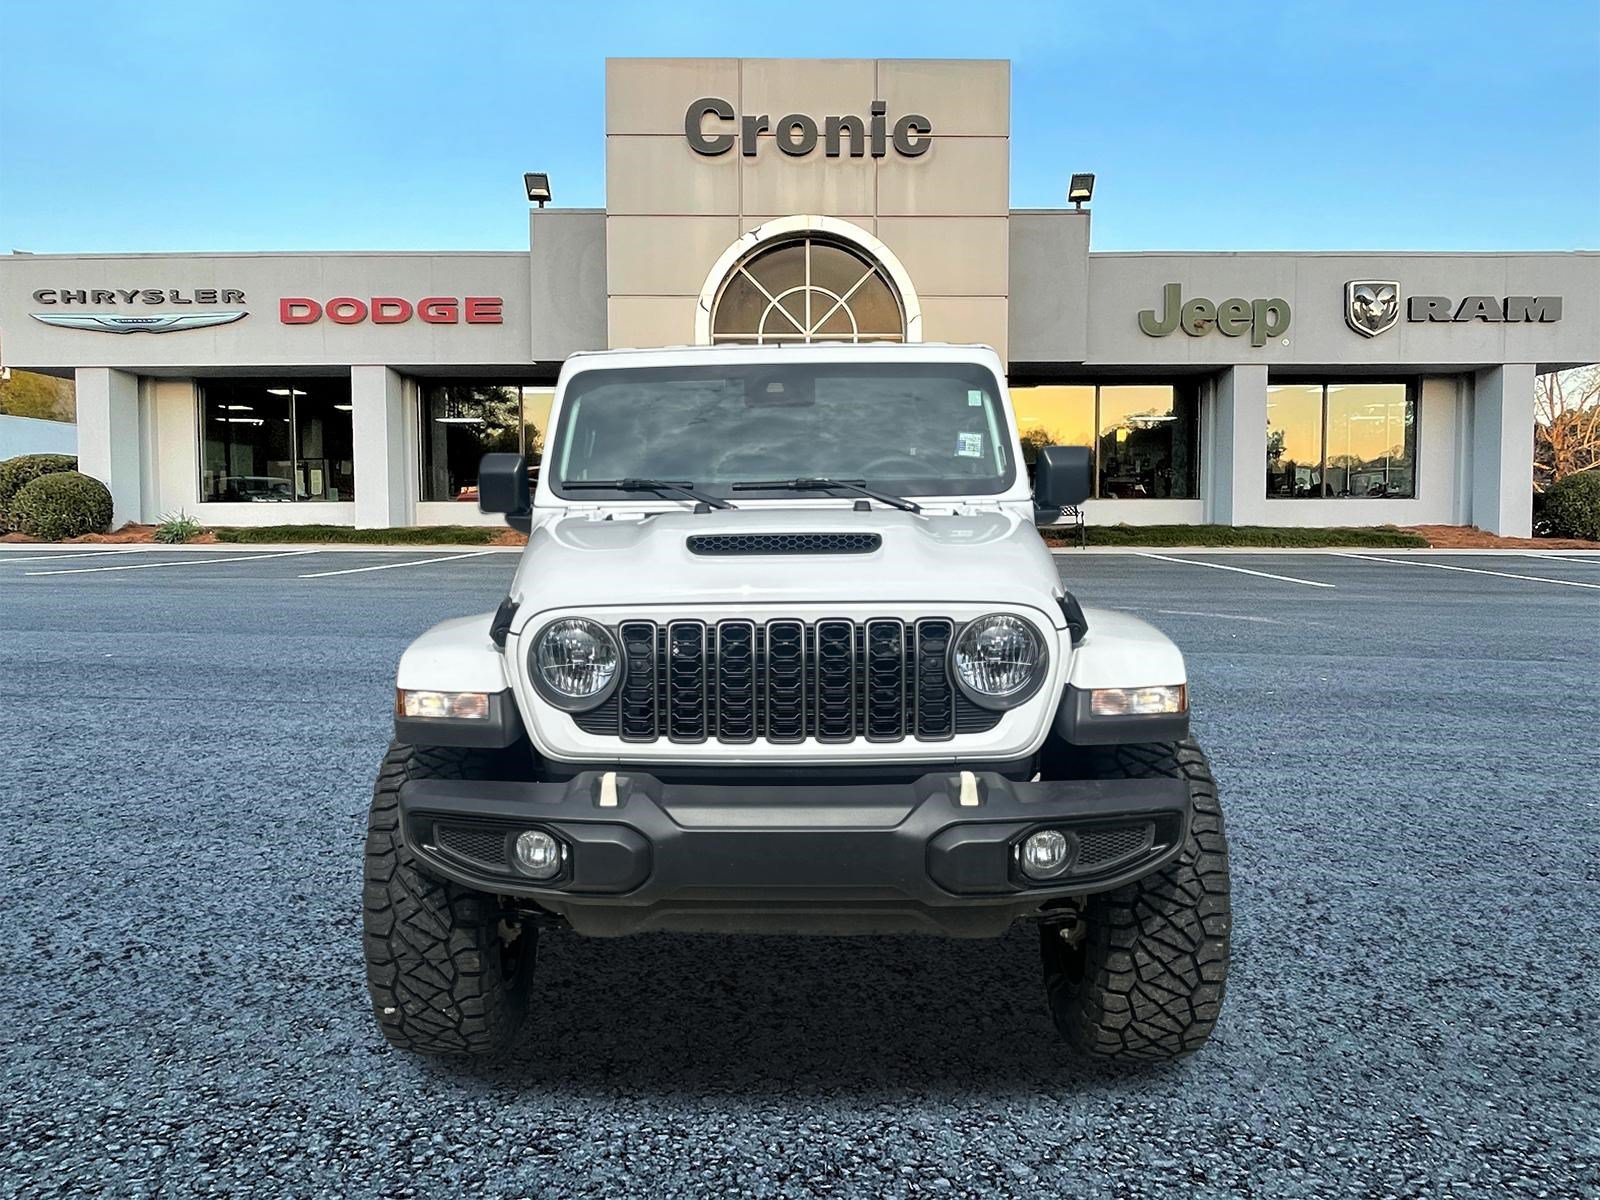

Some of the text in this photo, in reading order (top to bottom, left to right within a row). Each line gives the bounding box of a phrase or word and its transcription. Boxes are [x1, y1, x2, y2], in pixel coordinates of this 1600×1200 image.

[685, 98, 932, 157] Cronic
[32, 288, 246, 305] CHRYSLER
[1407, 295, 1563, 322] RAM
[280, 297, 503, 325] DODGE
[1138, 283, 1291, 347] Jeep
